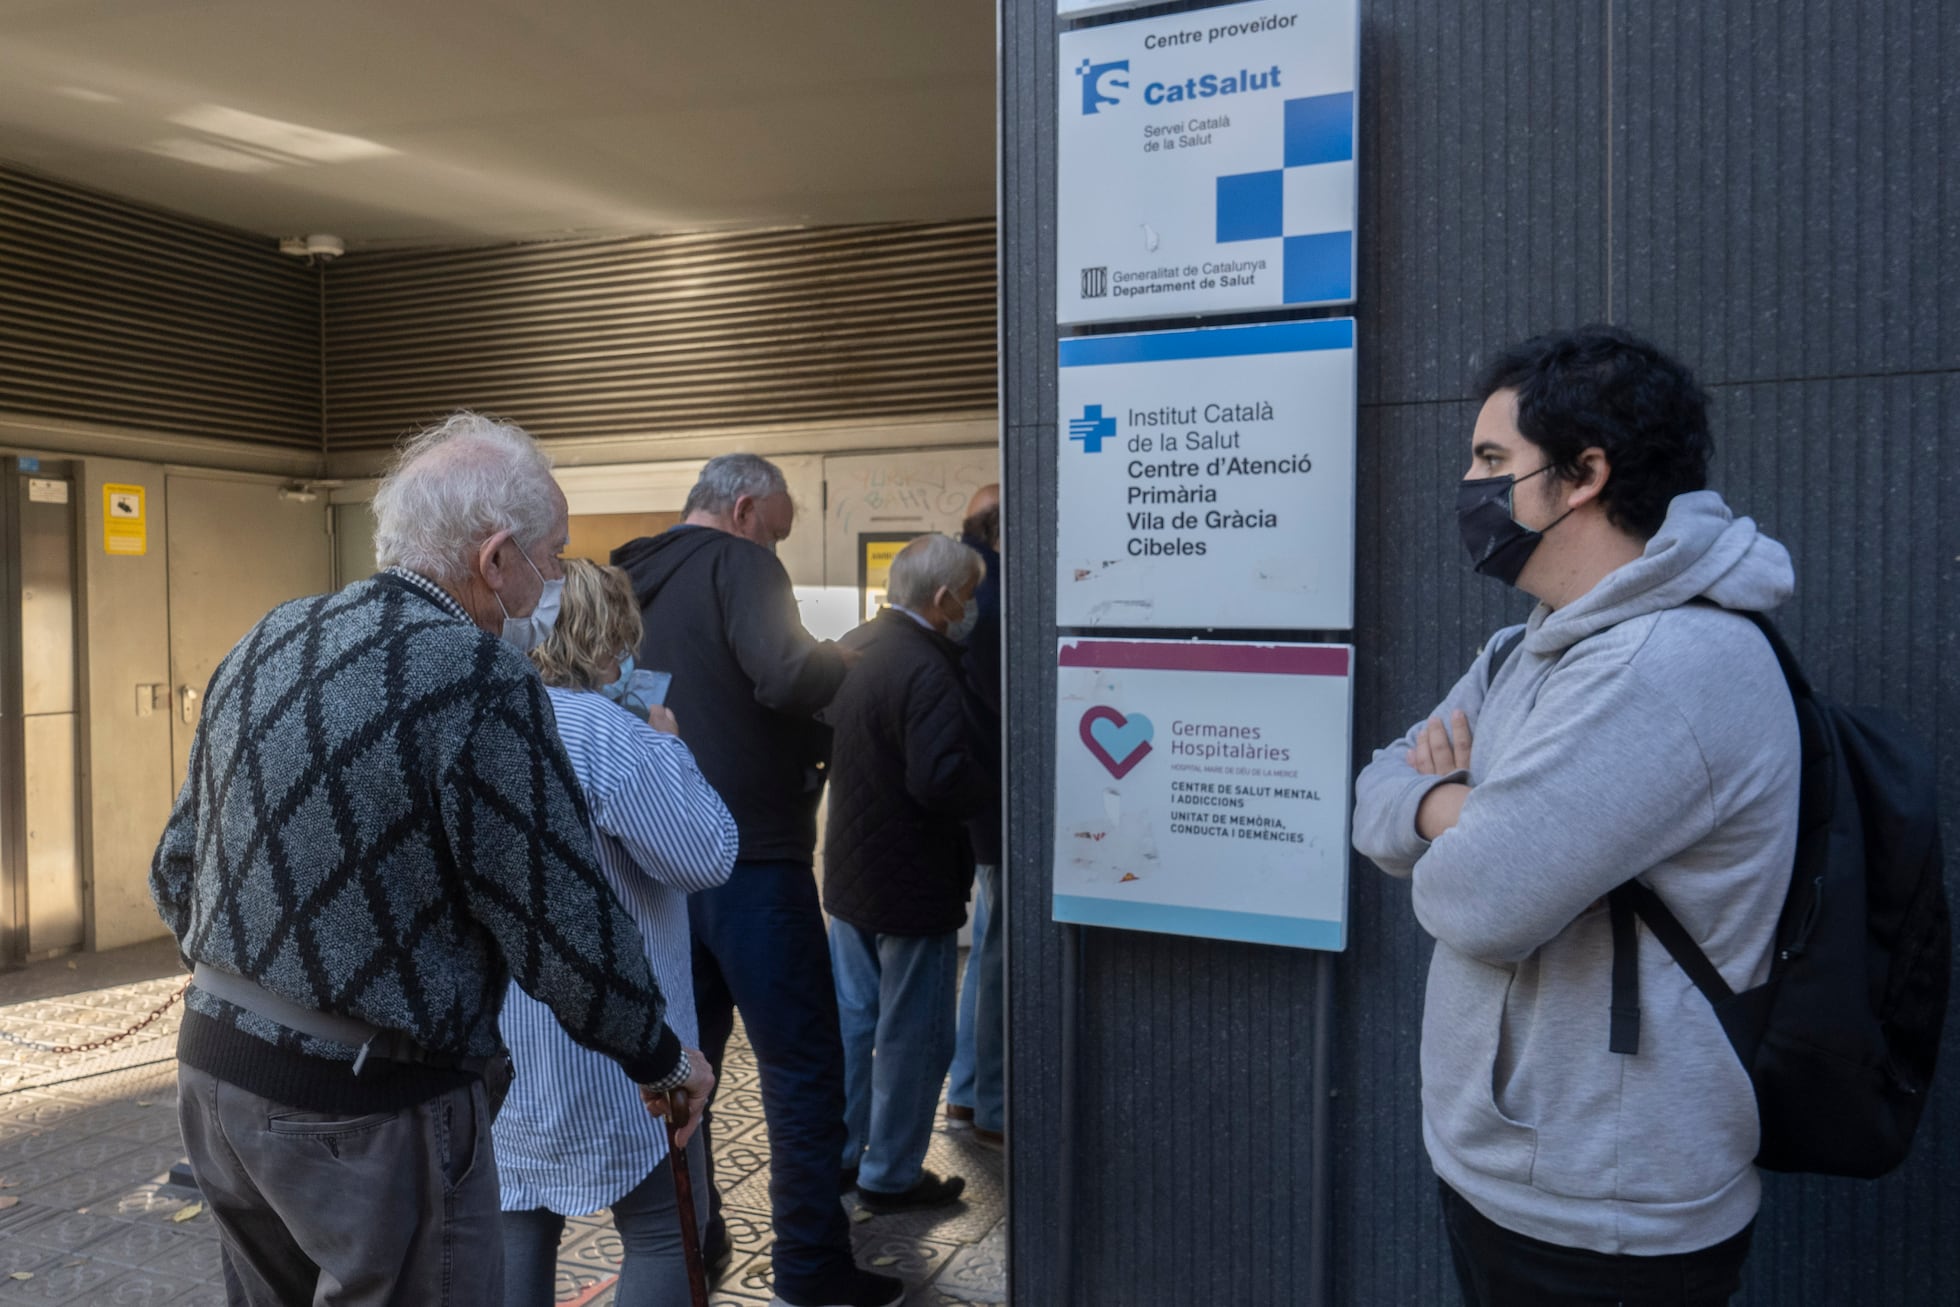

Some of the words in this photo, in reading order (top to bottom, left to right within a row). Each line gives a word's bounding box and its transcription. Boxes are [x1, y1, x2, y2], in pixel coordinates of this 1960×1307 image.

[1144, 30, 1202, 50] Centre
[1208, 14, 1298, 44] proveïdor
[1143, 65, 1281, 106] CatSalut
[1143, 121, 1184, 138] Servei
[1187, 115, 1231, 132] Català
[1143, 140, 1160, 152] de
[1163, 138, 1174, 150] la
[1178, 133, 1212, 148] Salut
[1112, 266, 1179, 283] Generalitat
[1182, 265, 1198, 277] de
[1202, 259, 1267, 275] Catalunya
[1112, 280, 1196, 298] Departament
[1199, 278, 1216, 289] de
[1219, 274, 1255, 288] Salut
[1128, 406, 1197, 427] Institut
[1204, 401, 1274, 423] Català
[1127, 434, 1153, 453] de
[1160, 433, 1177, 451] la
[1185, 430, 1240, 451] Salut
[1127, 460, 1199, 478] Centre
[1206, 453, 1312, 476] d'Atenció
[1127, 484, 1217, 504] Primària
[1126, 511, 1164, 530] Vila
[1171, 511, 1198, 529] de
[1205, 509, 1277, 529] Gràcia
[1127, 537, 1207, 556] Cibeles
[1171, 720, 1261, 740] Germanes
[1171, 740, 1290, 761] Hospitalàries
[1251, 767, 1261, 776] DE
[1262, 768, 1272, 777] LA
[1171, 781, 1215, 794] CENTRE
[1217, 784, 1232, 794] DE
[1235, 785, 1271, 797] SALUT
[1274, 787, 1320, 801] MENTAL
[1177, 794, 1244, 808] ADDICCIONS
[1170, 811, 1209, 823] UNITAT
[1212, 813, 1226, 824] DE
[1229, 814, 1286, 830] MEMÒRIA,
[1170, 823, 1229, 837] CONDUCTA
[1238, 827, 1304, 843] DEMÈNCIES
